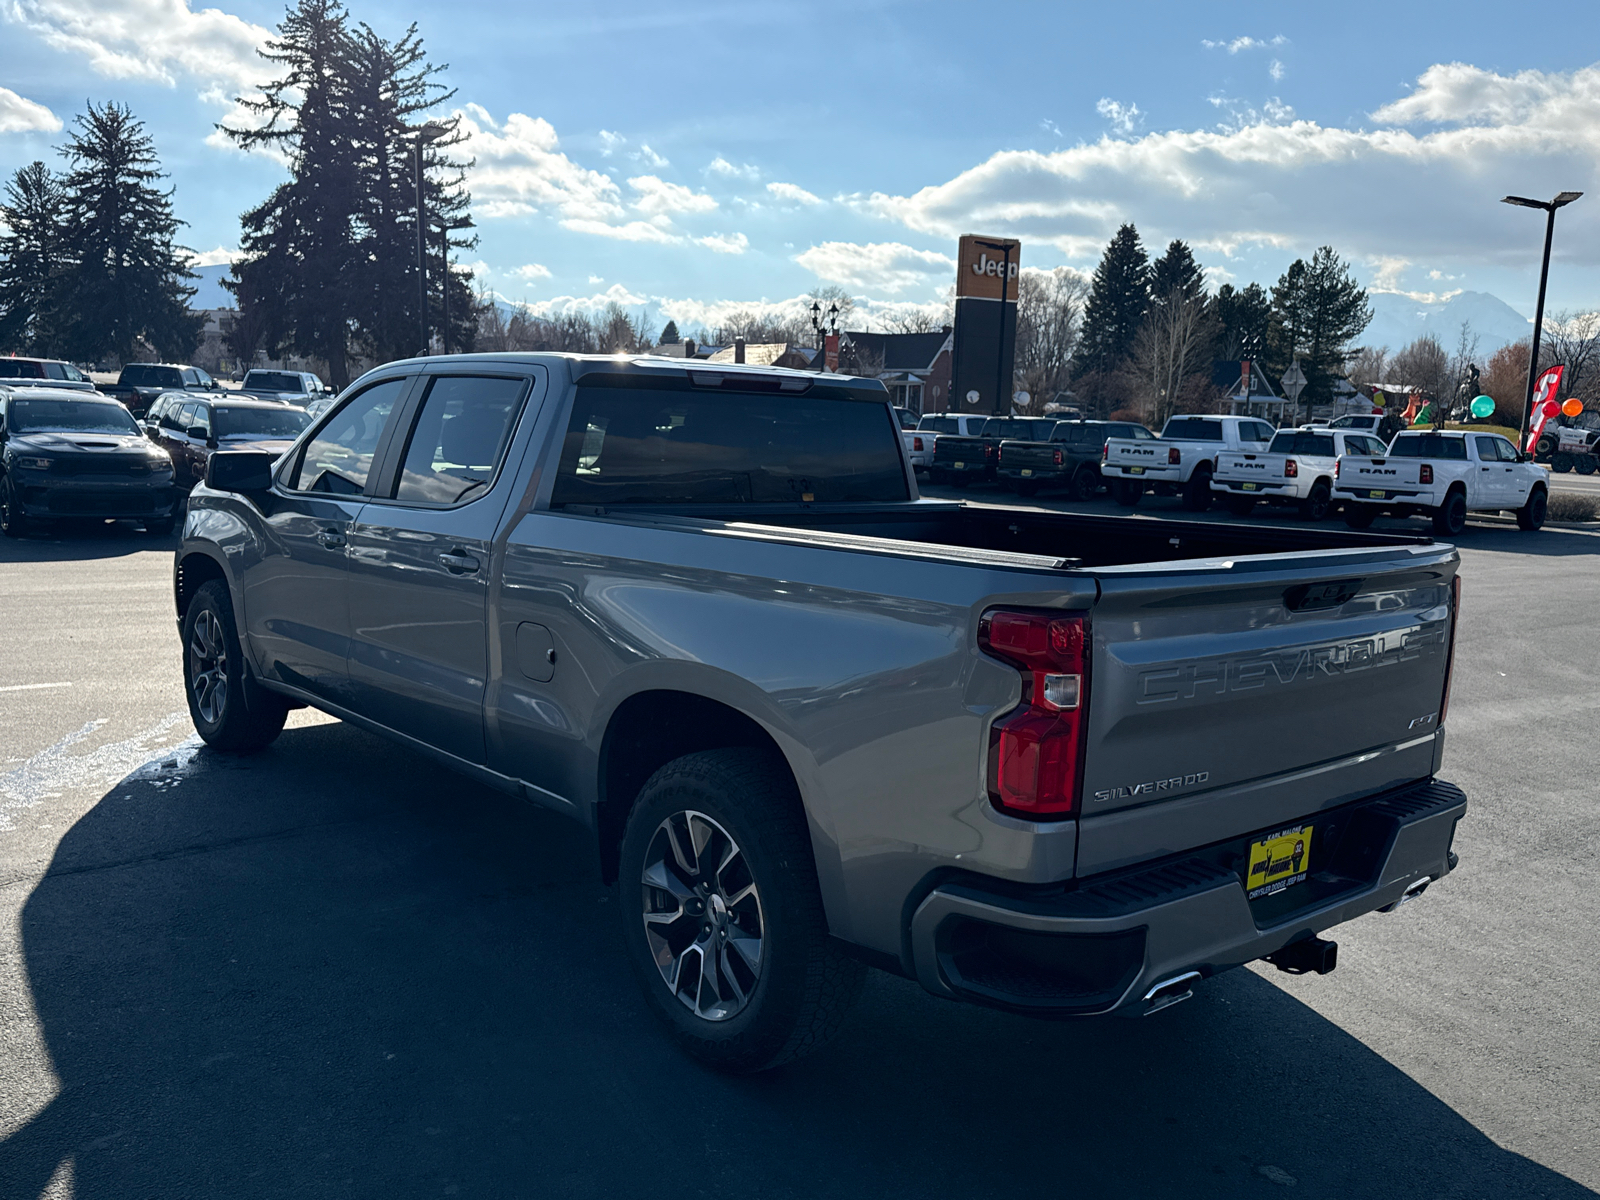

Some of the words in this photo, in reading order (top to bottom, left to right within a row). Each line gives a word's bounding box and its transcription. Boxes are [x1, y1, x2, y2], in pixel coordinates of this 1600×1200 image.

[972, 253, 1018, 282] Jeep
[1120, 448, 1154, 456] RAM
[1233, 462, 1266, 470] RAM
[1359, 467, 1397, 475] RAM
[1136, 626, 1446, 704] CHEVROLET
[1094, 771, 1209, 802] SILVERADO
[1267, 833, 1281, 841] KARL
[1295, 844, 1303, 853] 32
[1249, 886, 1271, 899] CHRYSLER
[1272, 880, 1286, 891] DODGE
[1287, 876, 1296, 886] JEEP
[1297, 873, 1307, 882] RAM
